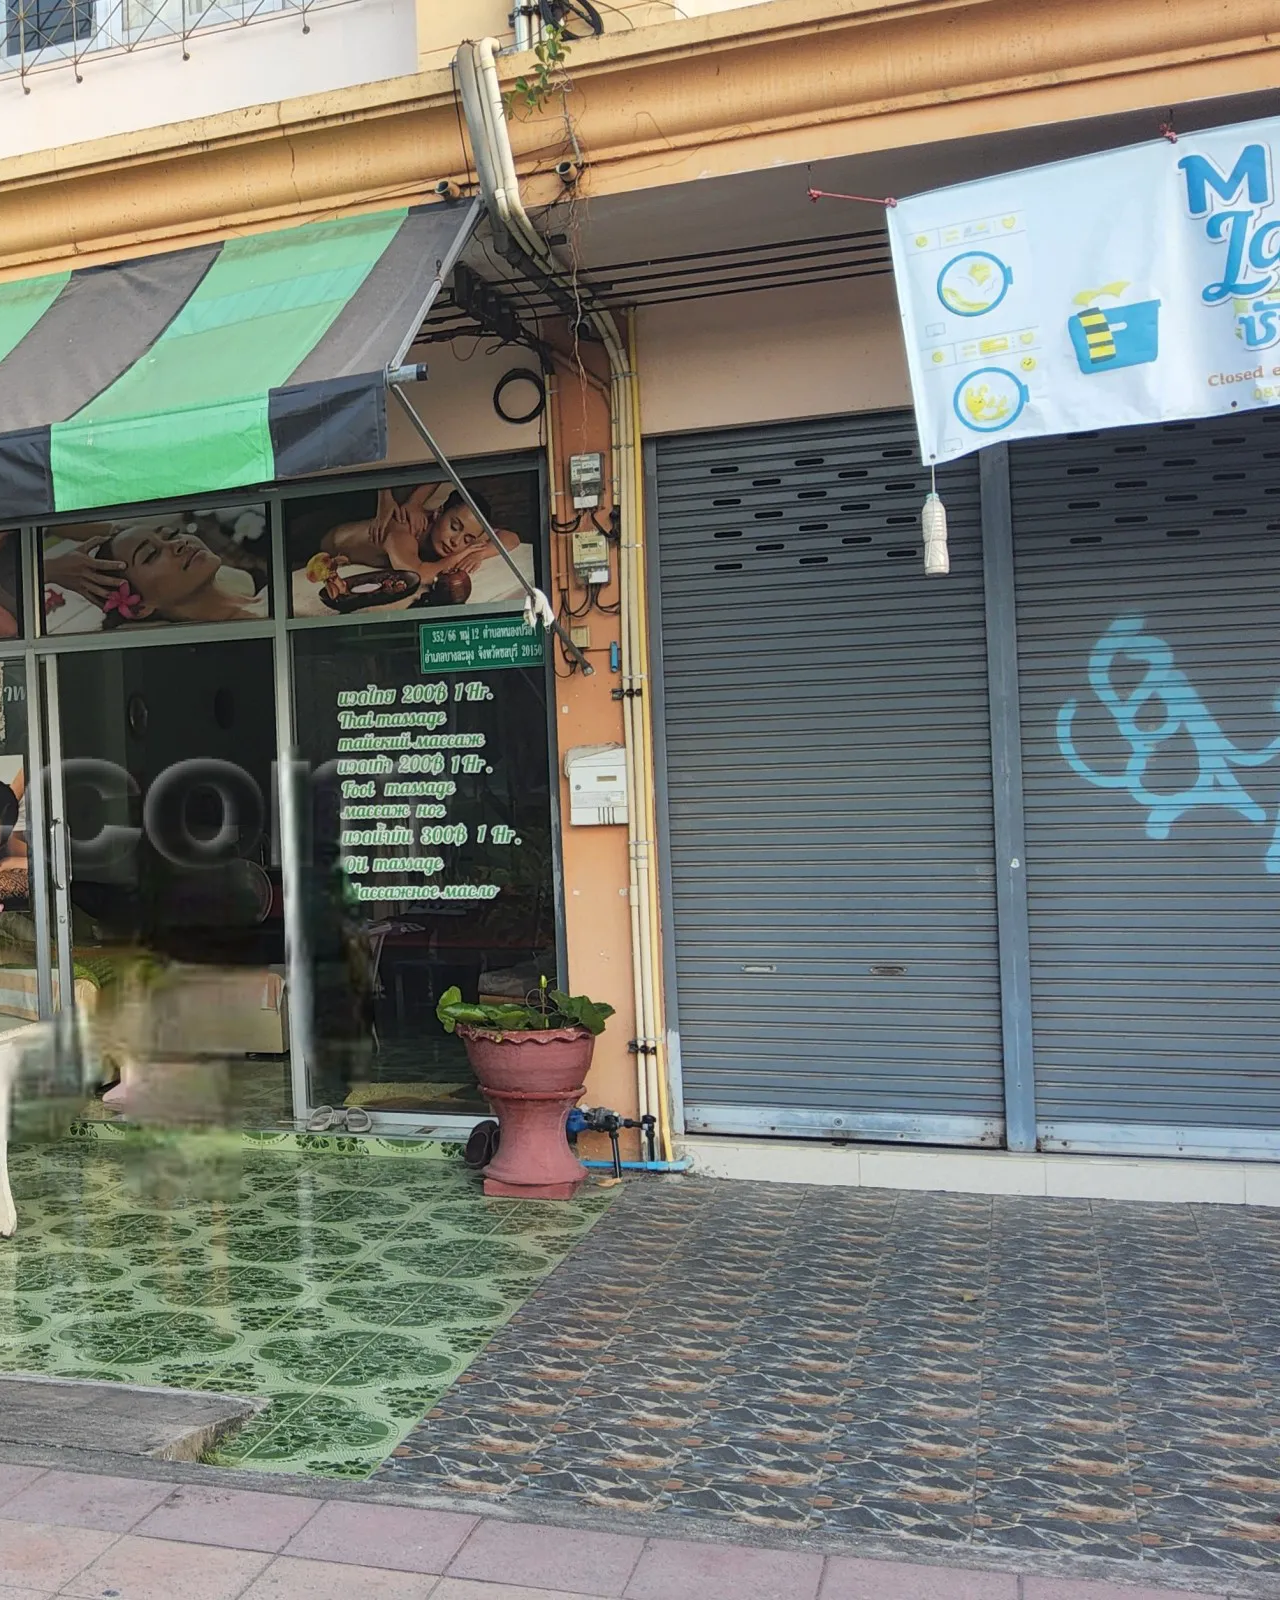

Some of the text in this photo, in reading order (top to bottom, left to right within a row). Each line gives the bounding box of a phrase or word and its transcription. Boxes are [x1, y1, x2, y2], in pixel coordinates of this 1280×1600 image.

[1208, 366, 1264, 386] Closed
[521, 644, 542, 657] 20150
[454, 682, 464, 701] 1
[464, 681, 494, 701] Hr.
[337, 711, 447, 730] Thai massage
[337, 732, 486, 752] тайский массаж
[451, 755, 460, 774] 1
[461, 754, 494, 774] Hr.
[341, 780, 456, 800] Foot massage
[340, 804, 447, 820] массаж ног
[477, 824, 487, 844] 1
[490, 824, 522, 845] Hr.
[344, 855, 445, 876] Oil massage
[440, 884, 500, 900] масло
